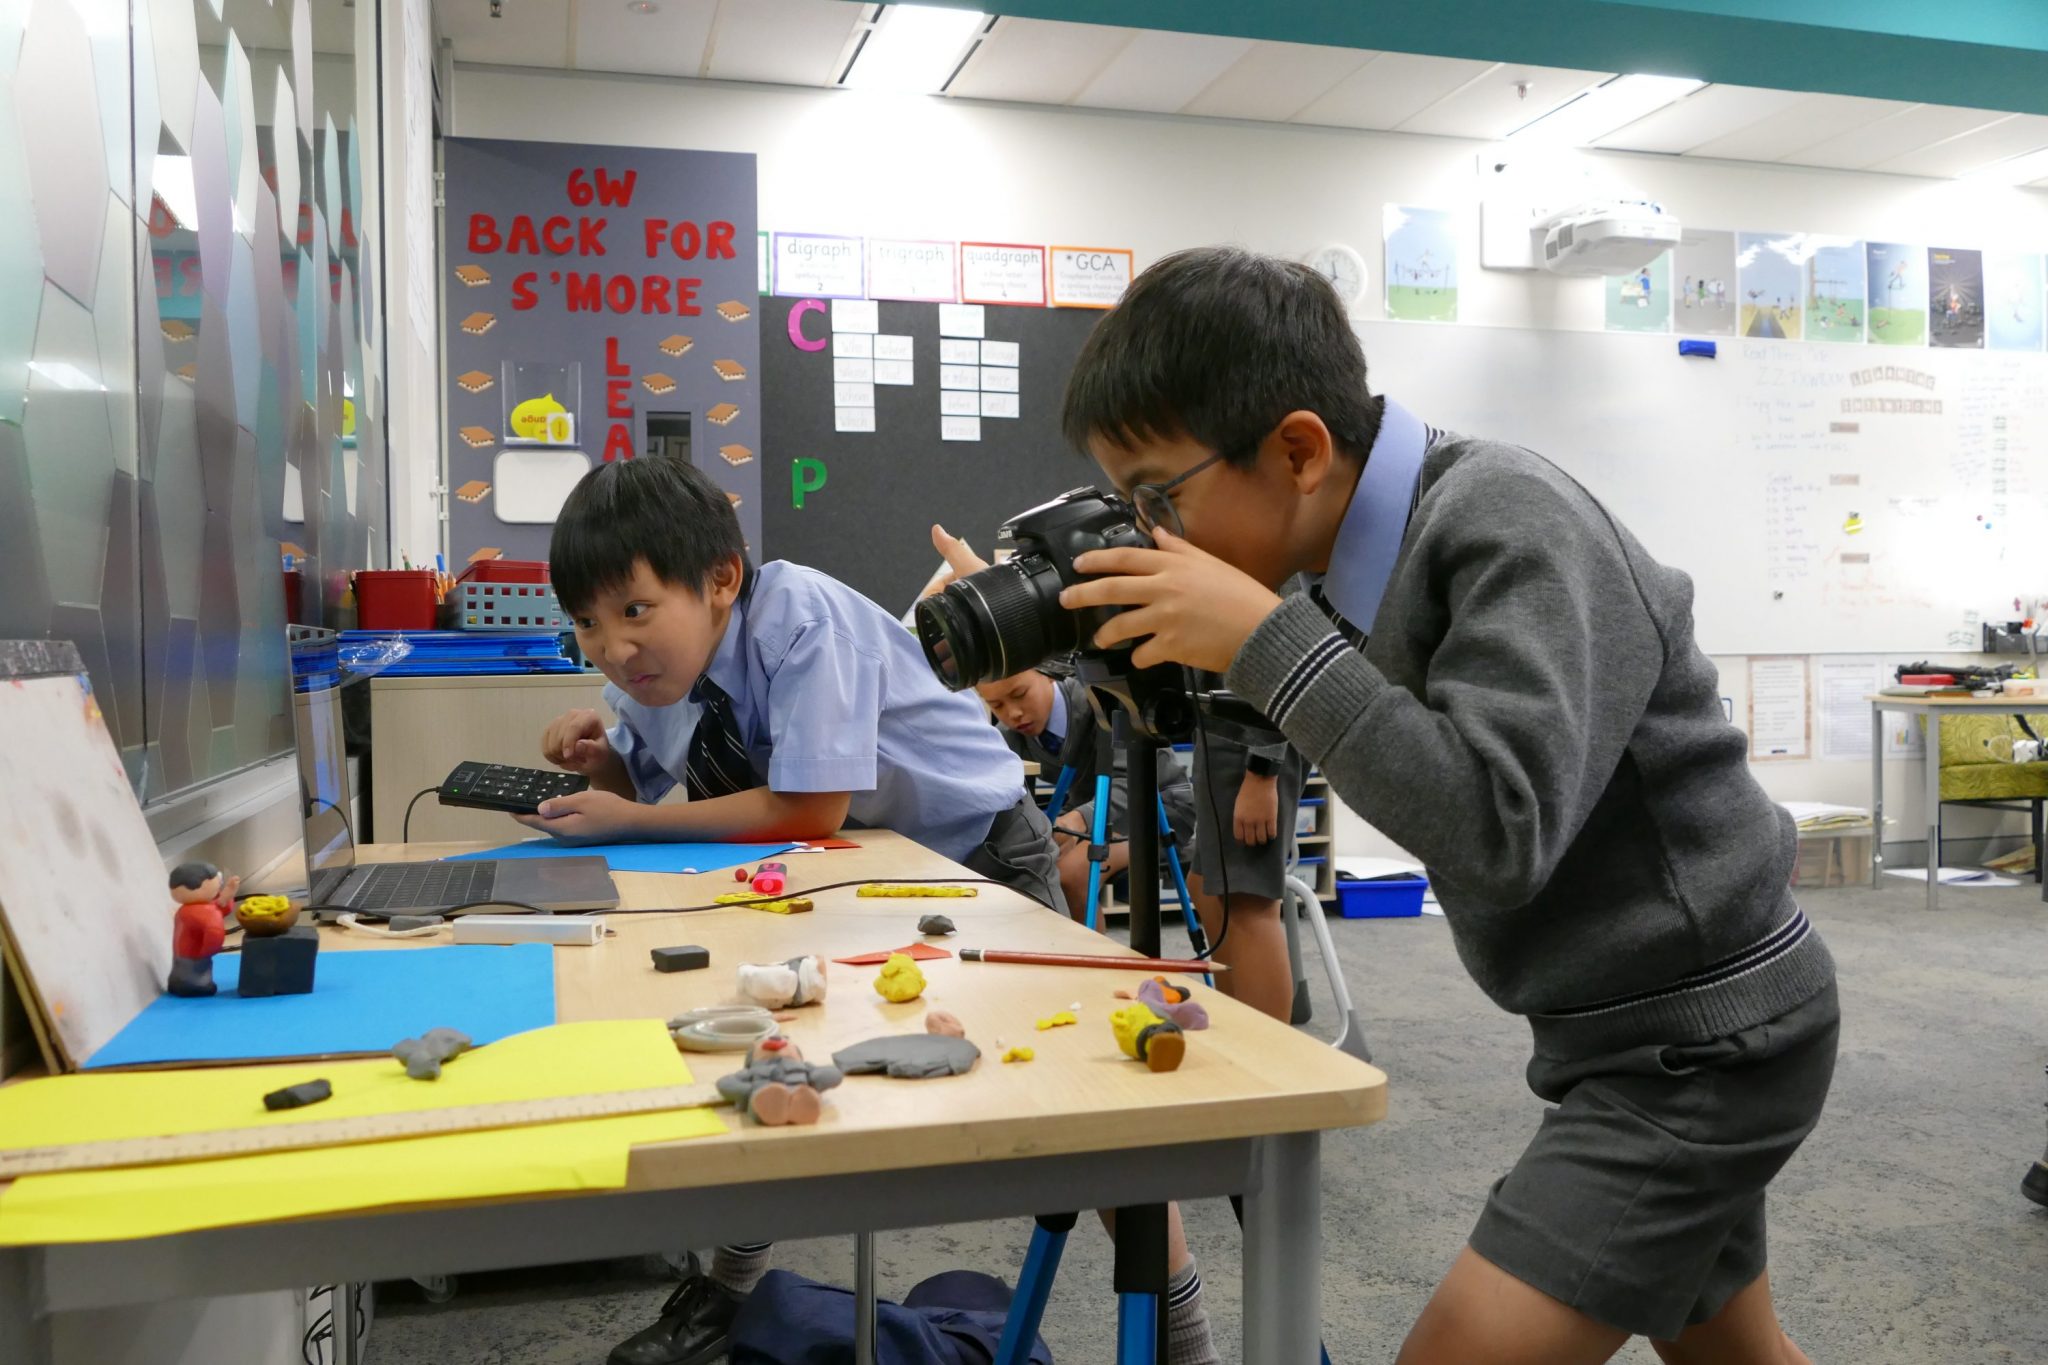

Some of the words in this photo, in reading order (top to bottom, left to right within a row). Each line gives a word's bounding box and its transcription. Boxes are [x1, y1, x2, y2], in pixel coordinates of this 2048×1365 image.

[566, 167, 638, 208] 6W
[467, 212, 608, 257] BACK
[643, 218, 737, 260] FOR
[787, 238, 851, 262] digraph
[879, 246, 945, 265] trigraph
[966, 248, 1039, 268] quadgraph
[511, 271, 703, 317] S'MORE
[787, 299, 827, 352] C
[521, 415, 547, 424] ange
[791, 456, 828, 509] P
